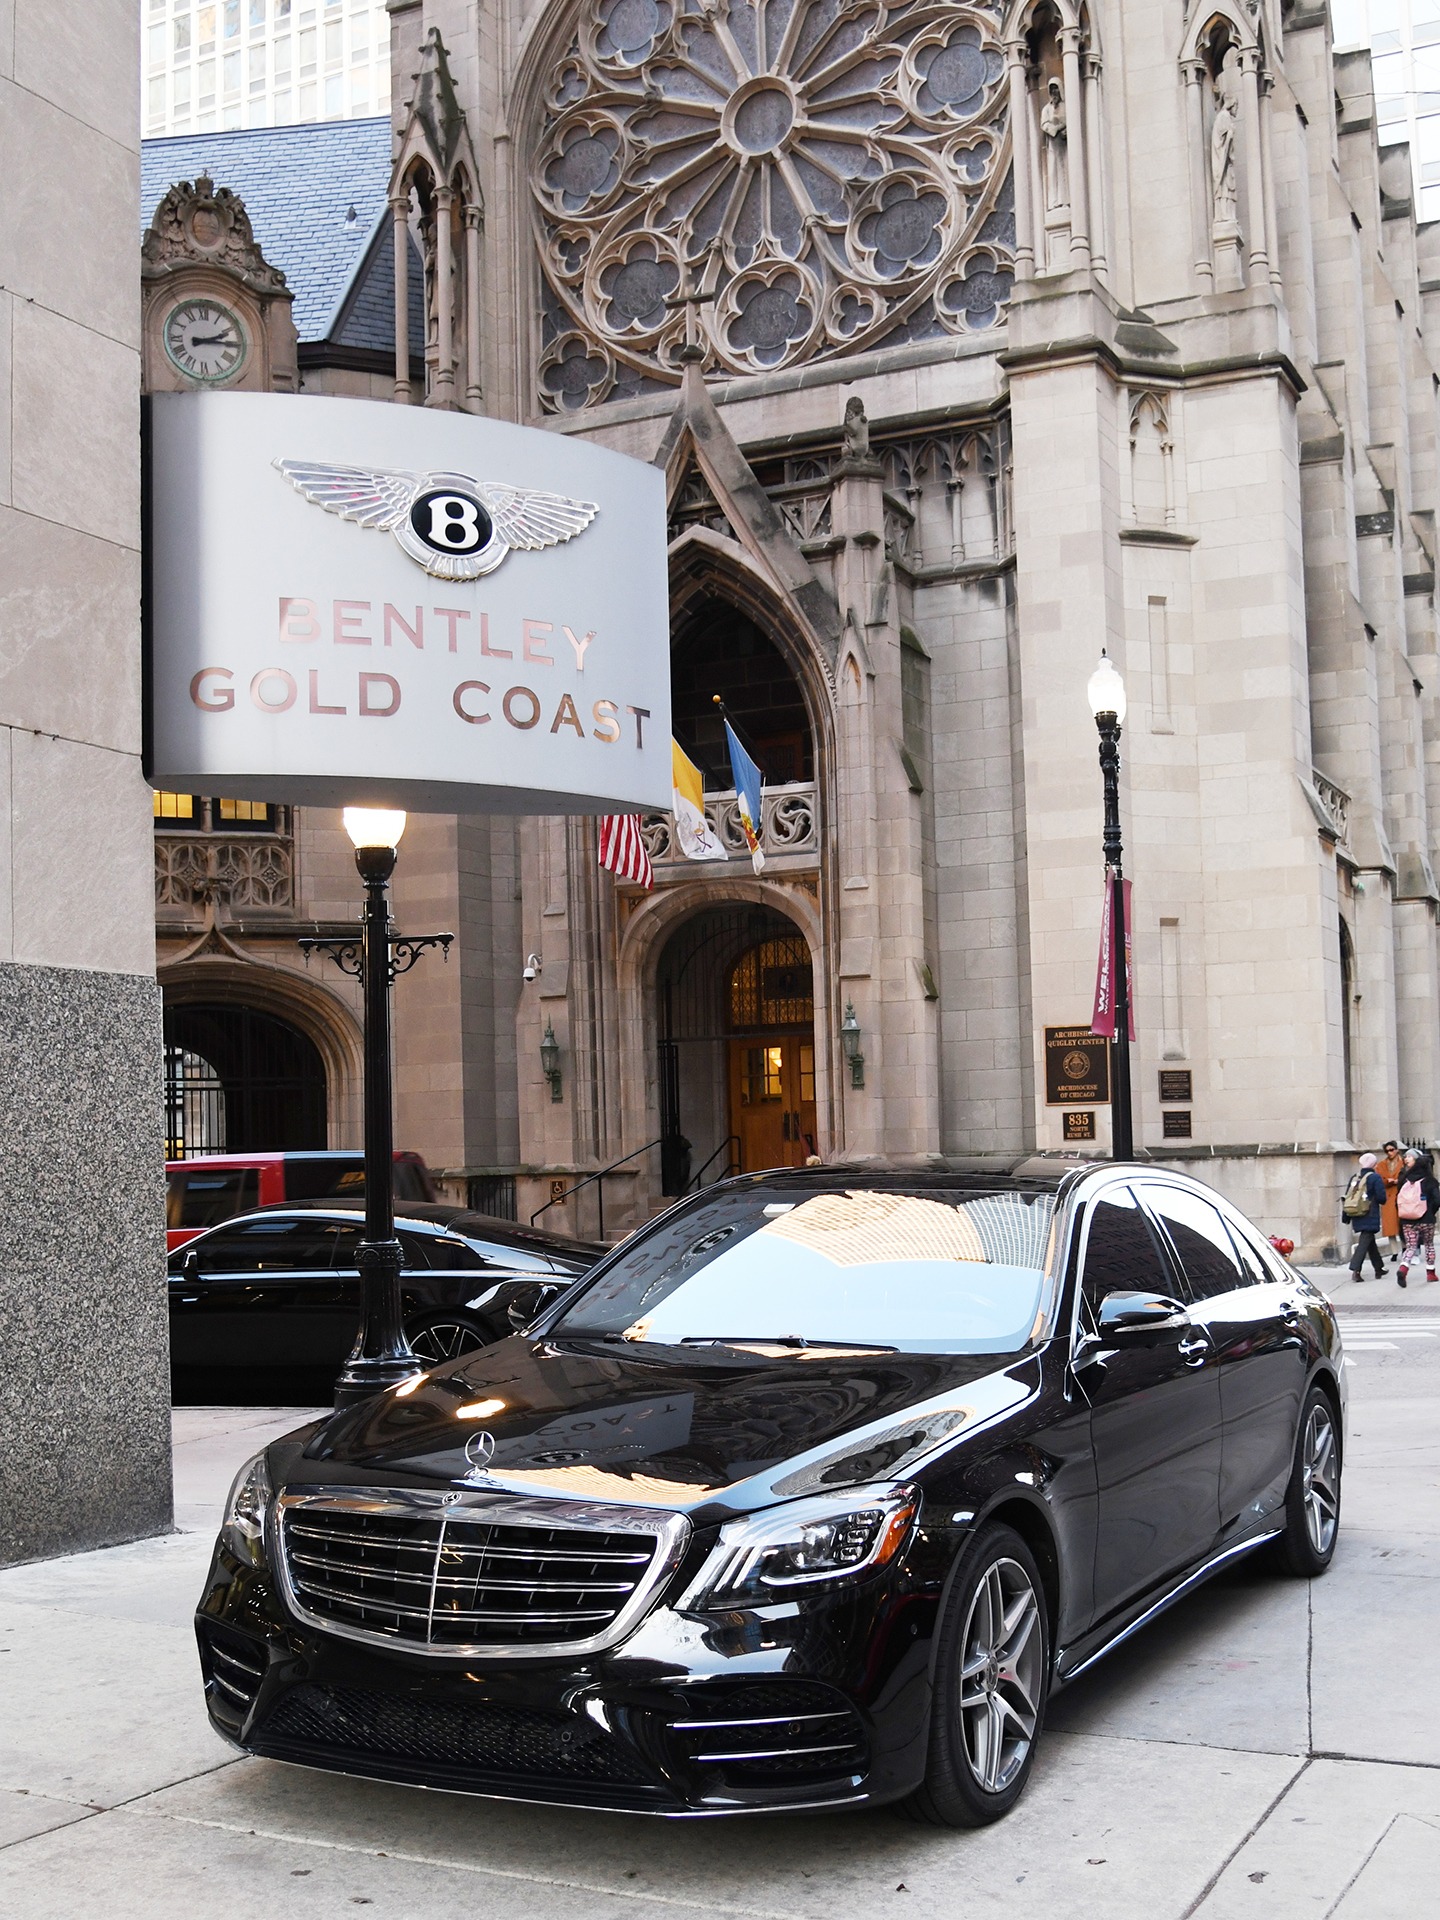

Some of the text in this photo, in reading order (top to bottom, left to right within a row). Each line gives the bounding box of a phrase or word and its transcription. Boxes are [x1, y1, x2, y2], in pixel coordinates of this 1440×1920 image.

[428, 495, 480, 550] B
[278, 596, 597, 673] BENTLEY
[189, 666, 651, 750] GOLD COAST
[1047, 1038, 1105, 1048] QUIGLEY CENTER
[1054, 1030, 1096, 1038] ARCHBISHO
[1068, 1114, 1089, 1126] 835
